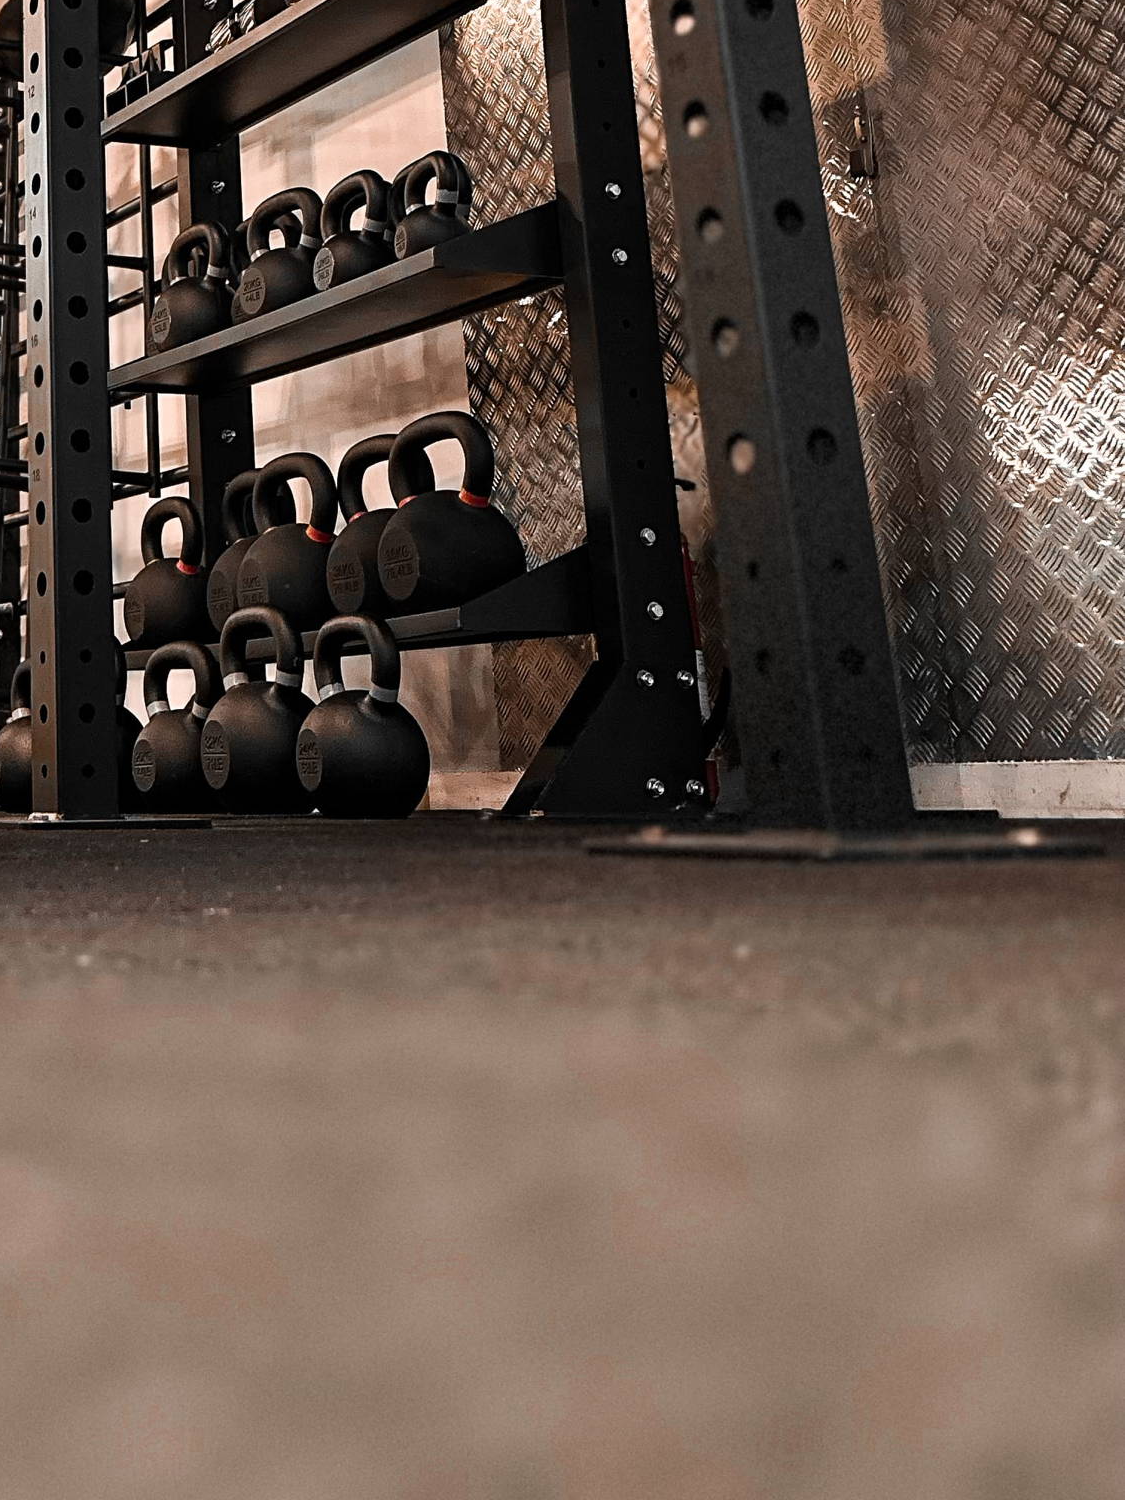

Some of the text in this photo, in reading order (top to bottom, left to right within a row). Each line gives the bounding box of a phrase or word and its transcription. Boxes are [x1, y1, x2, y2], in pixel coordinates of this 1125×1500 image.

[27, 85, 37, 100] 12
[28, 207, 38, 220] 14
[32, 469, 42, 483] 18
